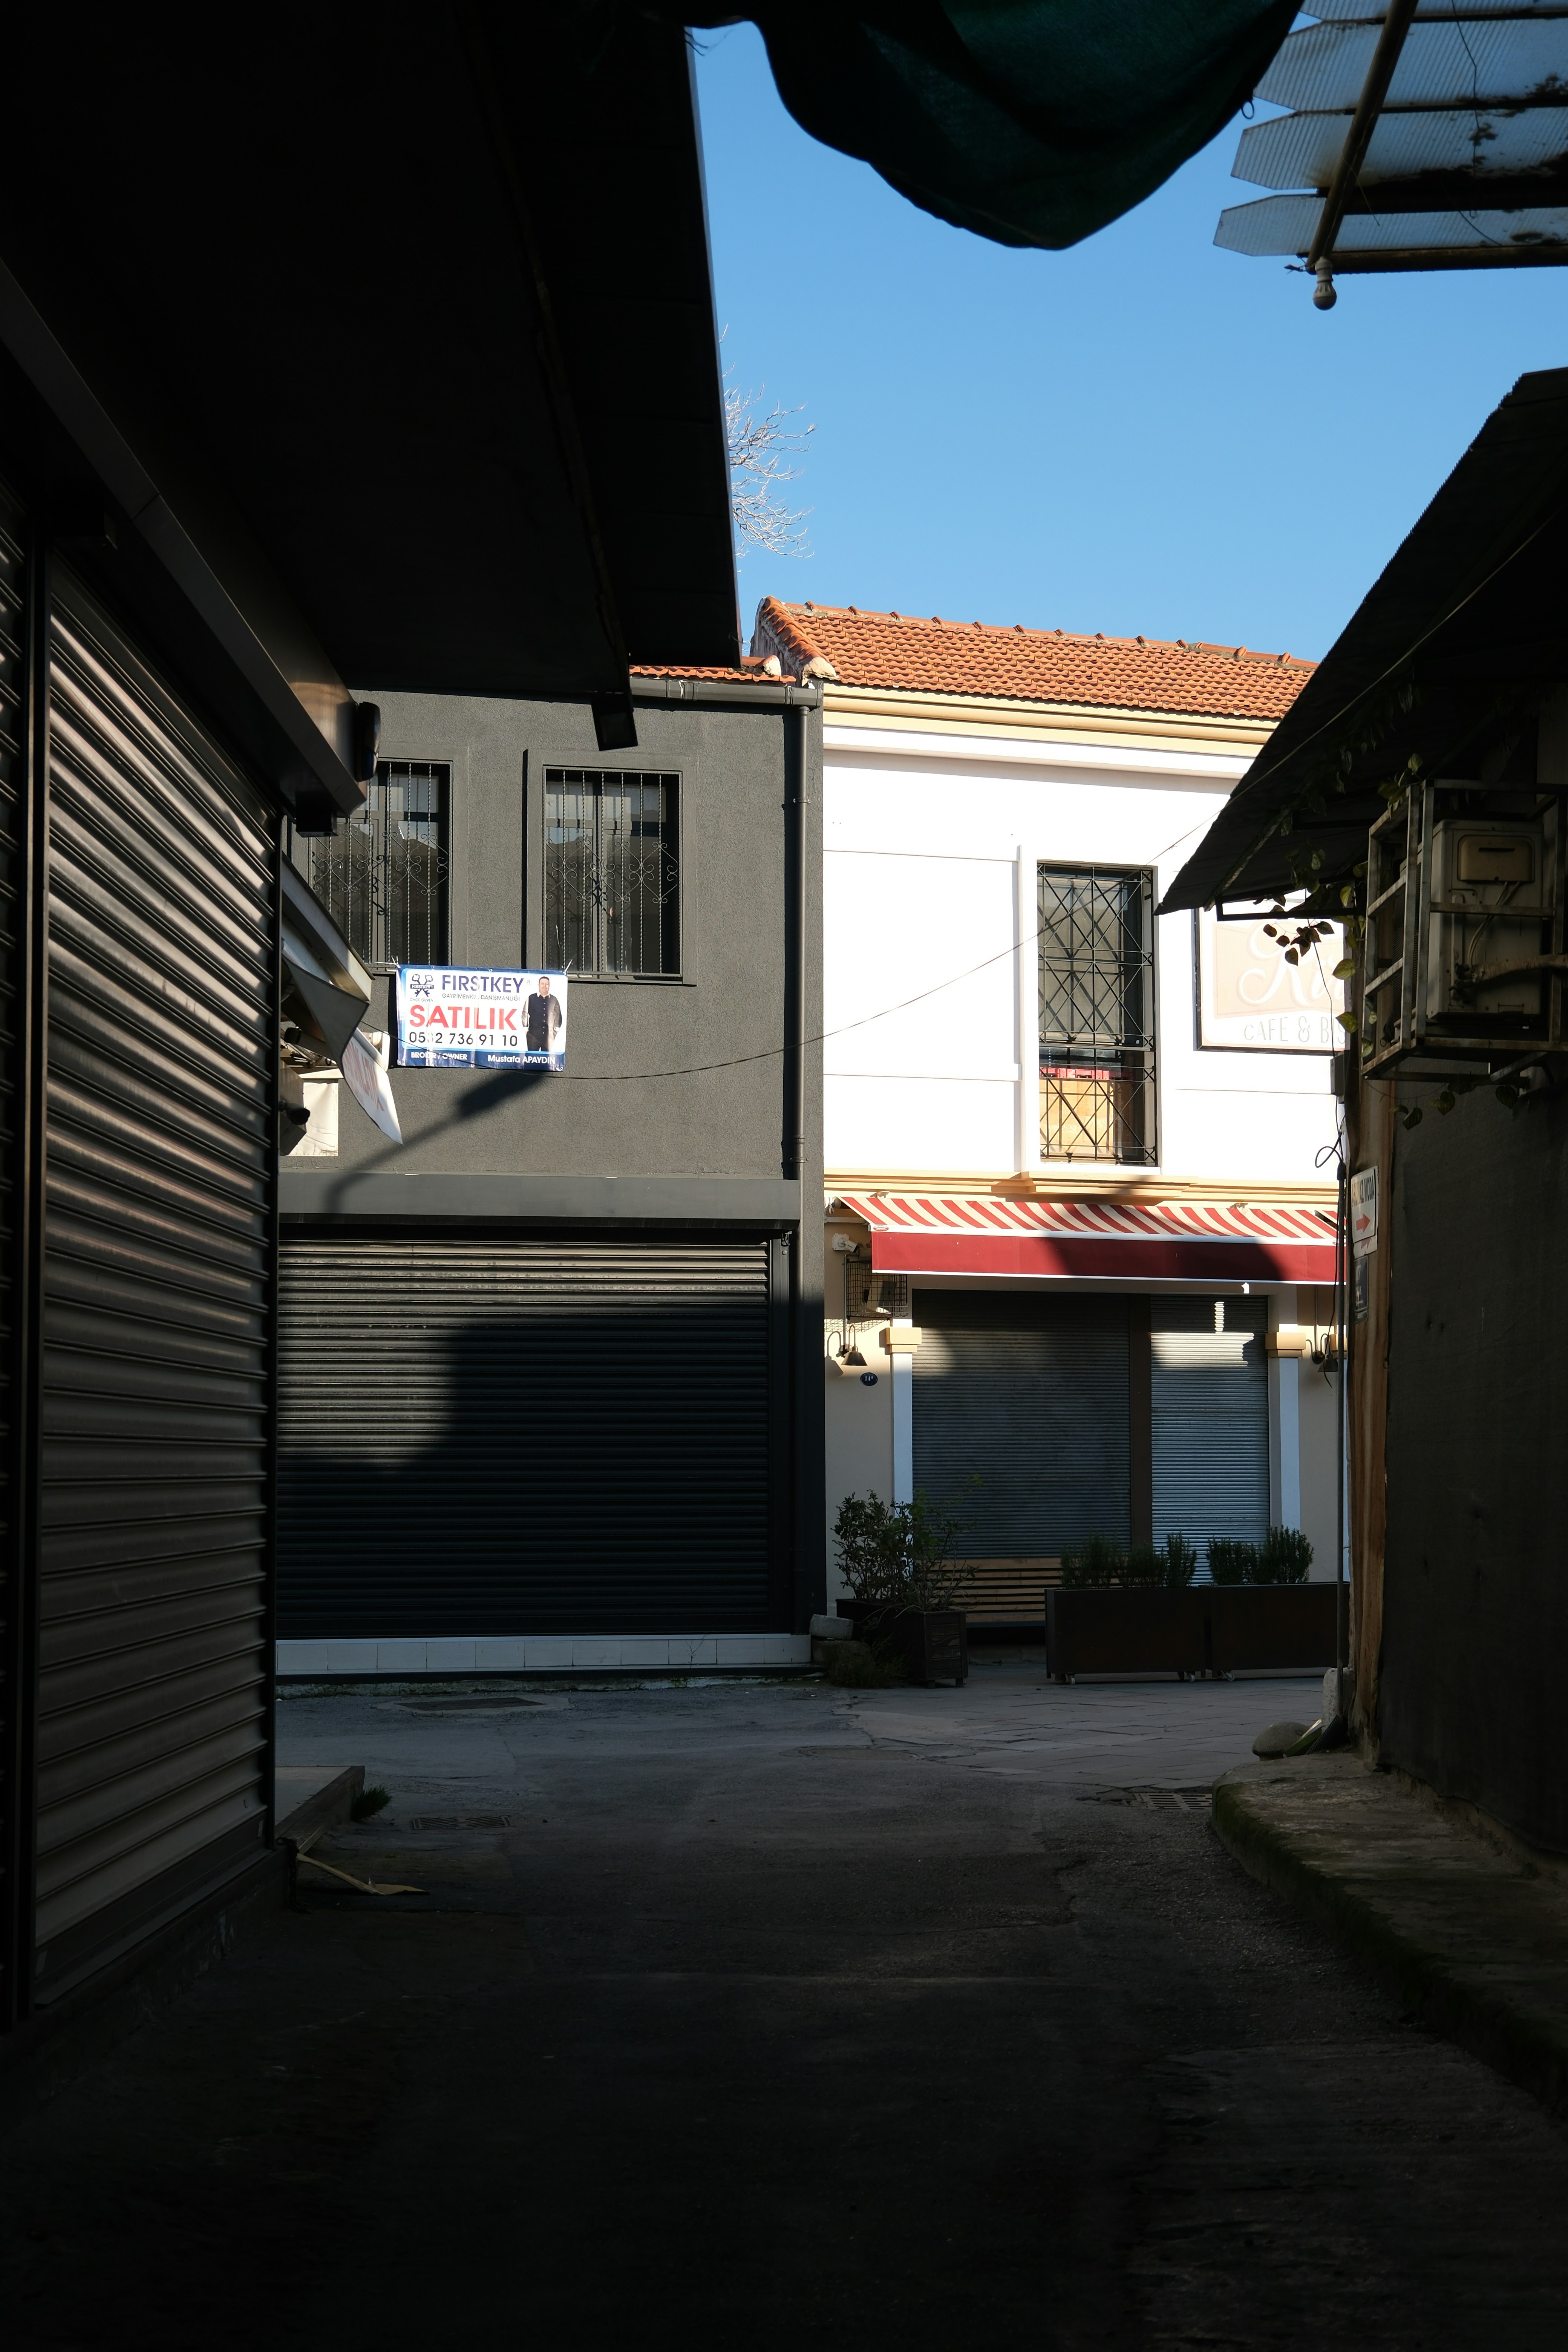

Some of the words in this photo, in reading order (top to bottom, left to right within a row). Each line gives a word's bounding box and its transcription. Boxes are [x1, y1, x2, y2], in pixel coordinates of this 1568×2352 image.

[442, 975, 524, 993] FIRSTKEY
[409, 1005, 517, 1030] SATILIK
[449, 1033, 473, 1045] 736
[479, 1034, 493, 1045] 91
[502, 1035, 518, 1046] 10
[1243, 1017, 1289, 1041] CAFE
[1298, 1016, 1311, 1043] &
[488, 1055, 521, 1063] Mustafa
[1364, 1175, 1375, 1202] MODA
